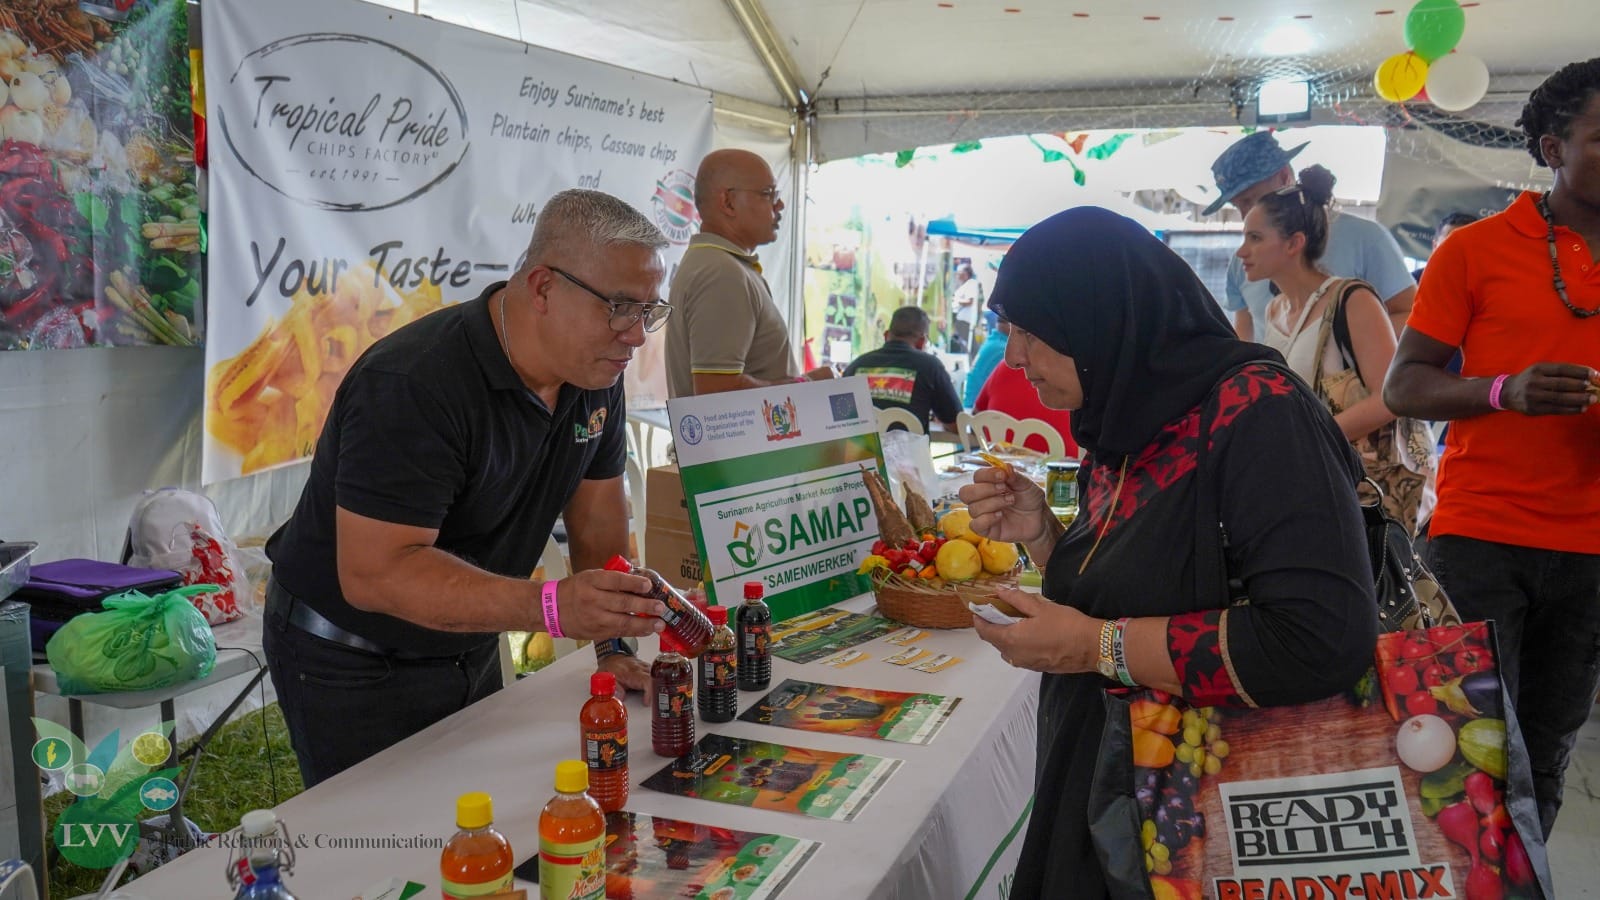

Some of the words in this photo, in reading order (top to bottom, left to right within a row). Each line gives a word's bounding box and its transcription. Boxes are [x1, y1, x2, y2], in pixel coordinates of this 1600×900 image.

[254, 76, 381, 152] Tropical
[379, 97, 449, 147] Pride
[519, 76, 559, 108] Enjoy
[565, 84, 635, 118] Suriname's
[639, 103, 665, 123] best
[307, 141, 356, 158] CHIPS
[490, 112, 551, 143] Plantain
[556, 125, 593, 154] chips,
[601, 133, 646, 160] Cassava
[649, 141, 678, 166] chips
[577, 169, 602, 189] and
[245, 237, 348, 307] Your
[717, 503, 754, 520] Suriname
[755, 495, 795, 512] Agriculture
[795, 490, 818, 502] Market
[820, 485, 843, 497] Access
[843, 480, 865, 492] Projec
[764, 497, 871, 555] SAMAP
[1113, 641, 1125, 670] SAVE
[1230, 790, 1398, 829] READY
